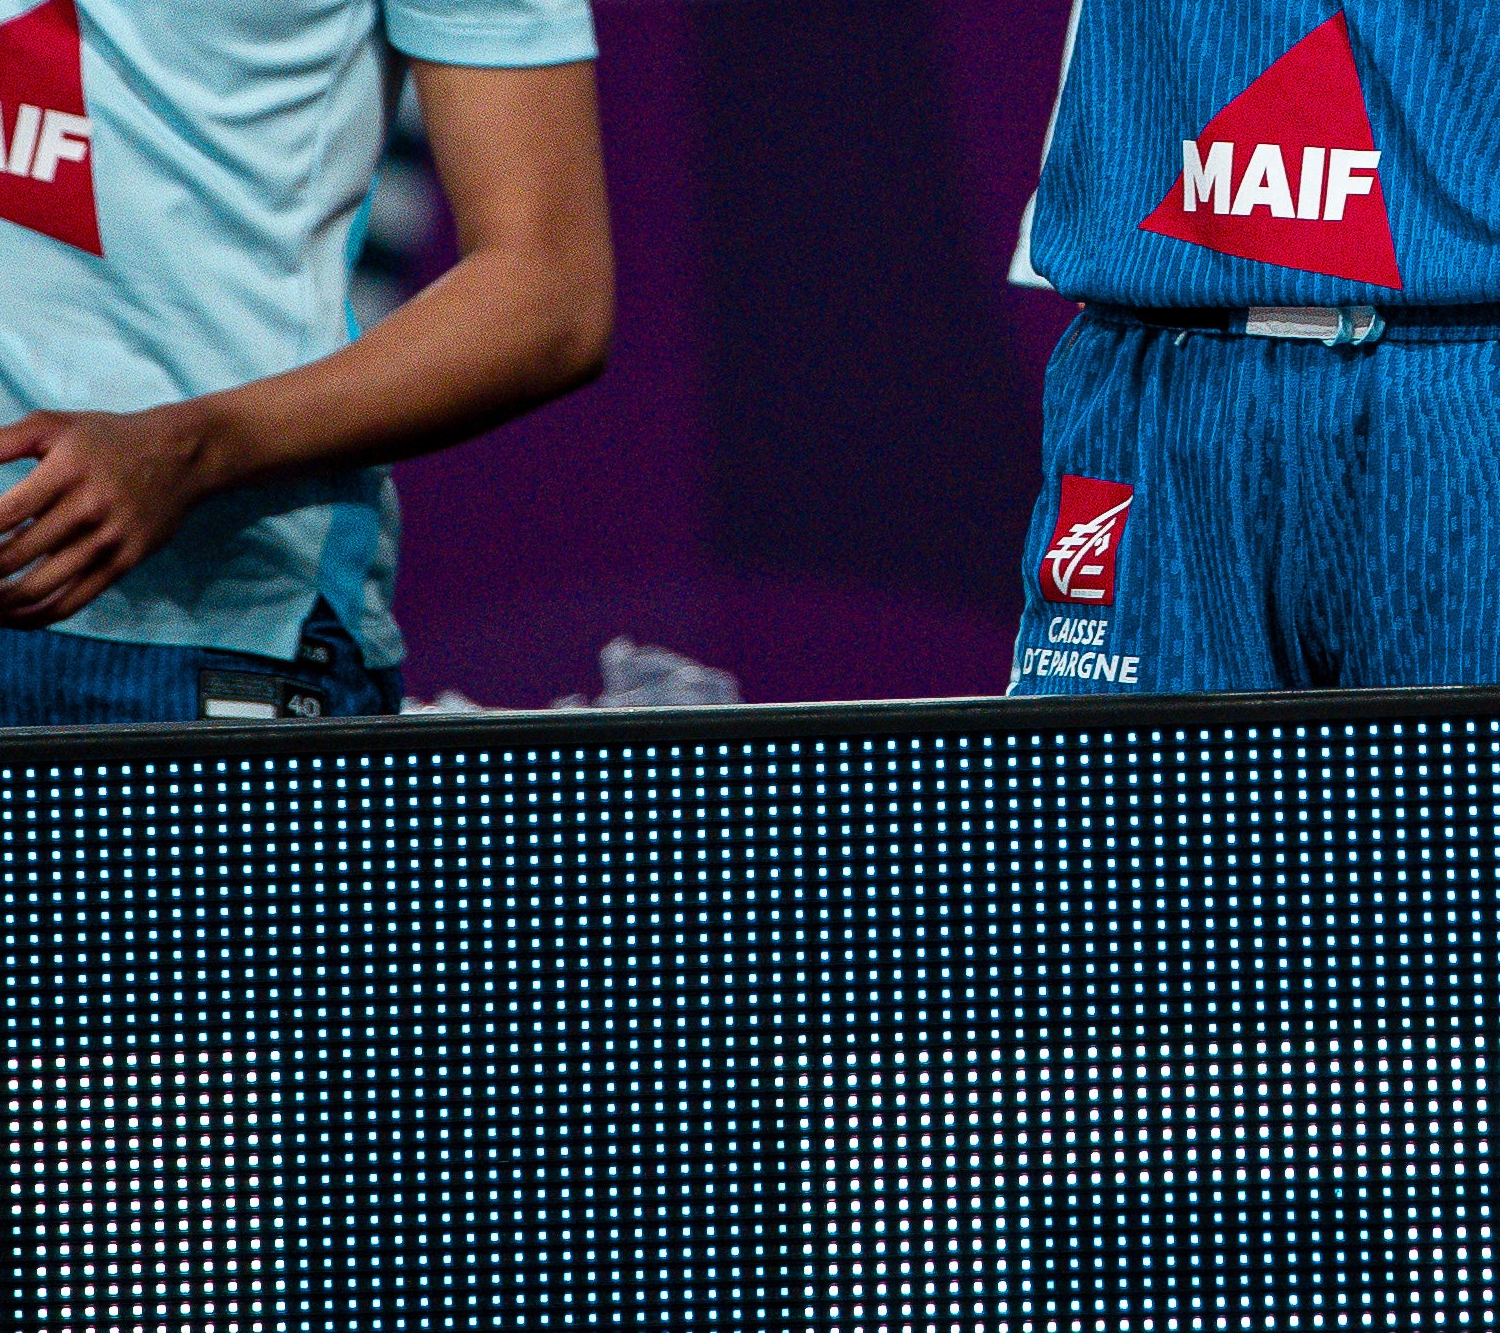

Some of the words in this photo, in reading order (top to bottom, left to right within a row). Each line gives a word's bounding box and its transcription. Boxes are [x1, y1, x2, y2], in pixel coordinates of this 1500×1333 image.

[1182, 140, 1382, 222] MAIF
[1048, 616, 1108, 646] CAISSE
[1022, 648, 1140, 684] D'EPARGNE
[287, 694, 321, 718] 40
